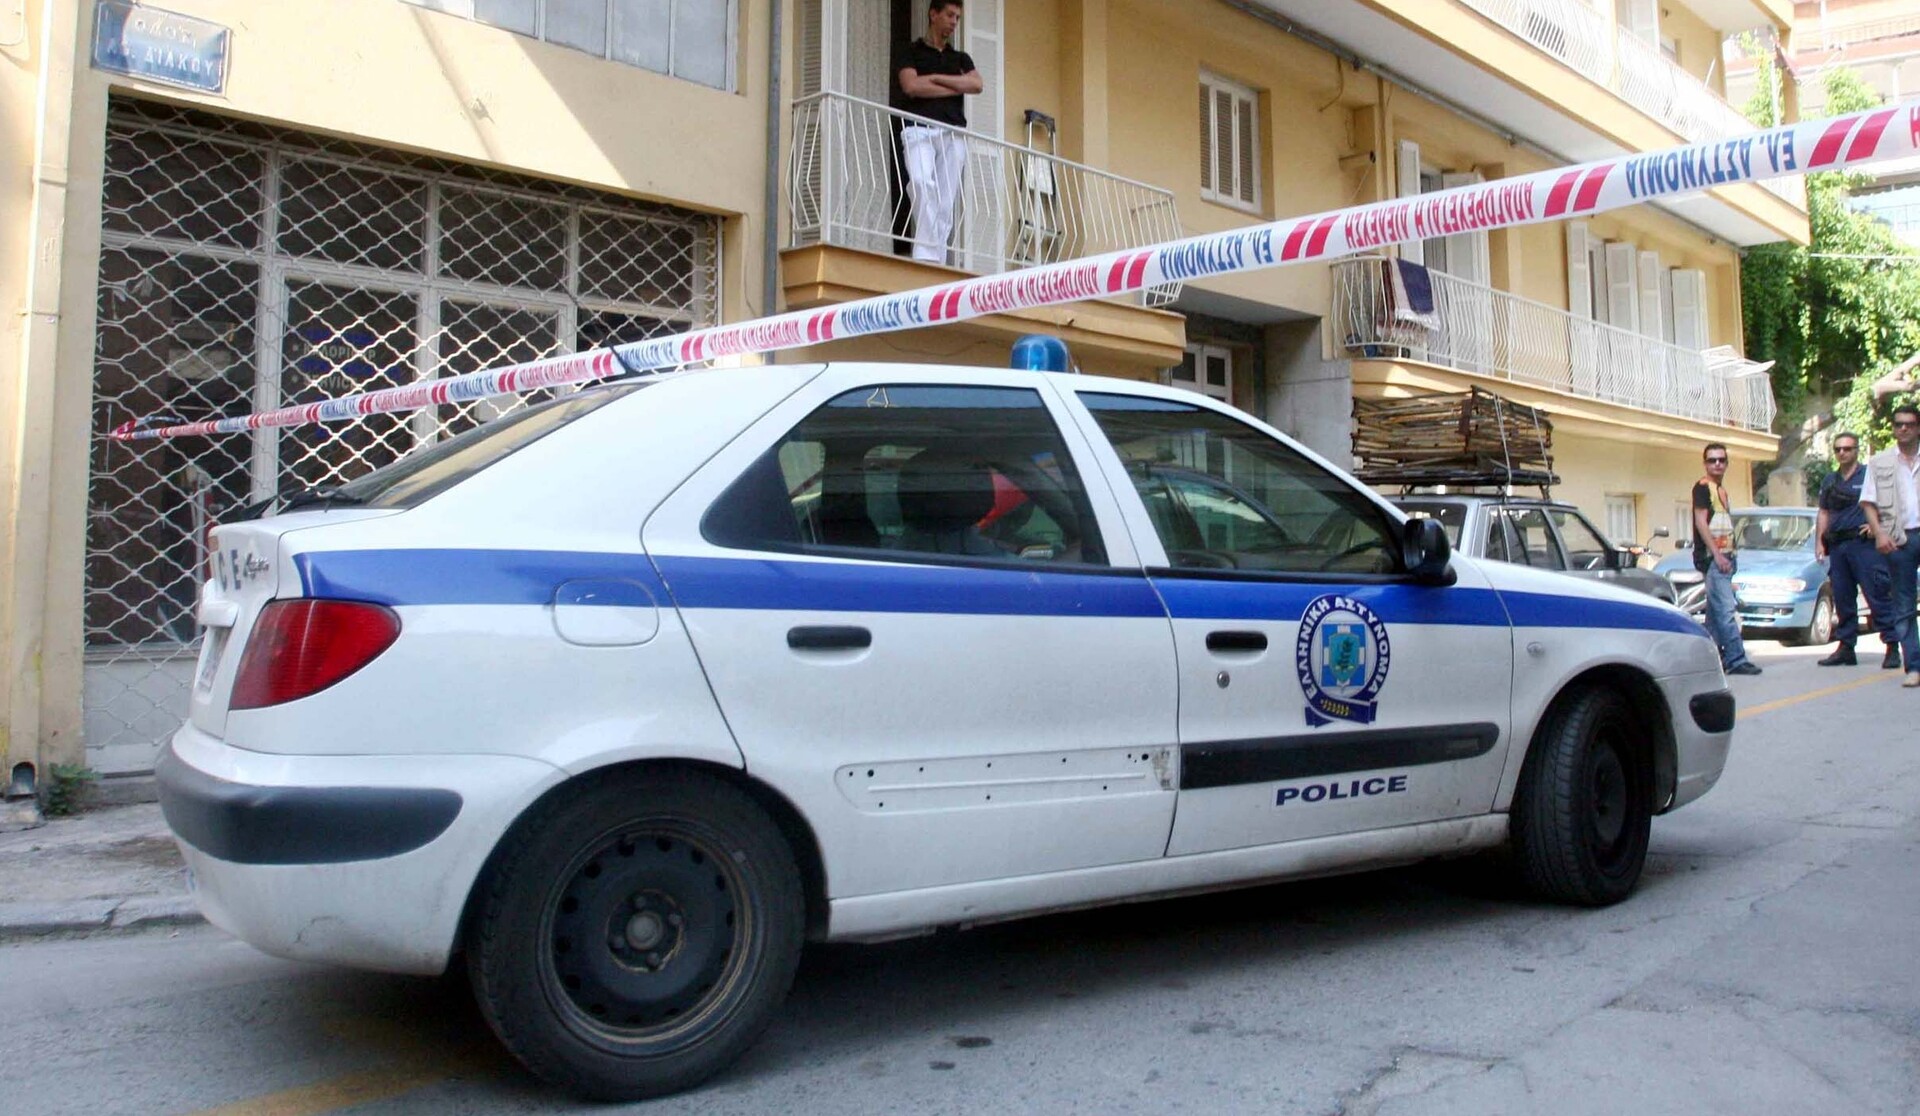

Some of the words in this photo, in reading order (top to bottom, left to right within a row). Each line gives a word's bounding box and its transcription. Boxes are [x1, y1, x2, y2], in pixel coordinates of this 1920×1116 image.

[1626, 137, 1753, 198] ΑΣΤΥΝΟΜΙΑ
[1344, 203, 1410, 249] ΔΙΕΛΕΥΣΗ
[1427, 180, 1535, 235] ΑΠΑΓΟΡΕΥΕΤΑΙ
[1159, 233, 1244, 280] ΑΣΤΥΝΟΜΙΑ
[1298, 597, 1330, 699] ΕΛΛΗΝΙΚΗ
[1335, 596, 1389, 694] ΑΣΤΥΝΟΜΙΑ
[1275, 775, 1408, 806] POLICE
